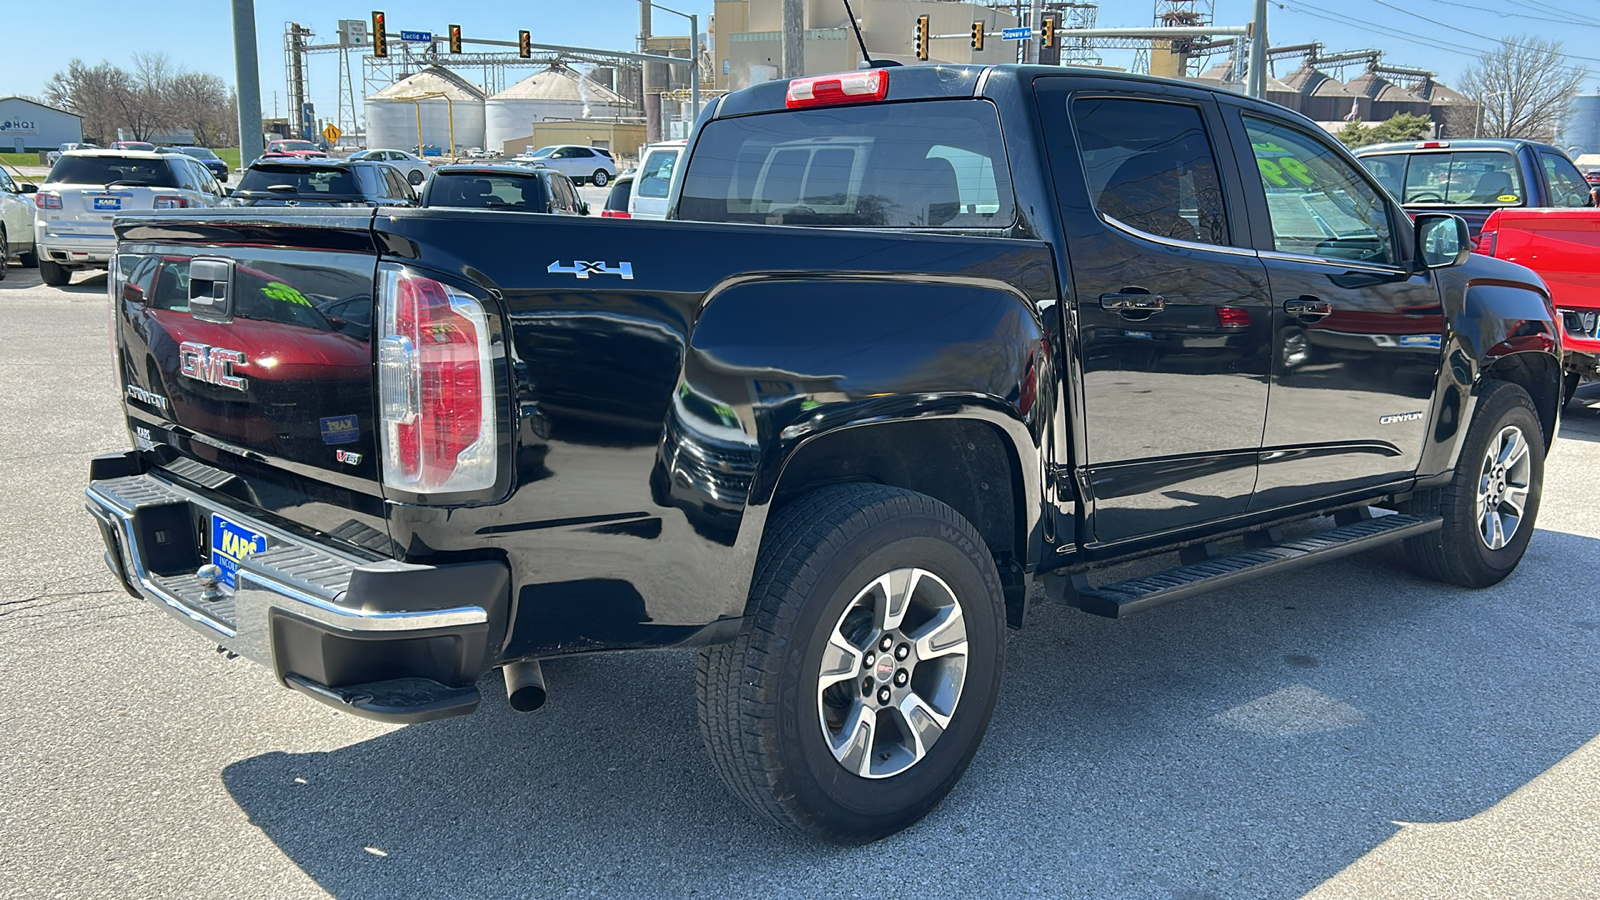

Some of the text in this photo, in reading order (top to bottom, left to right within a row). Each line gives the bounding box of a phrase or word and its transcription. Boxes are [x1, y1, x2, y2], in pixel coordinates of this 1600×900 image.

[13, 121, 35, 129] HQI
[180, 341, 248, 392] GMC
[1380, 411, 1423, 425] CANYON
[221, 529, 257, 560] KARS
